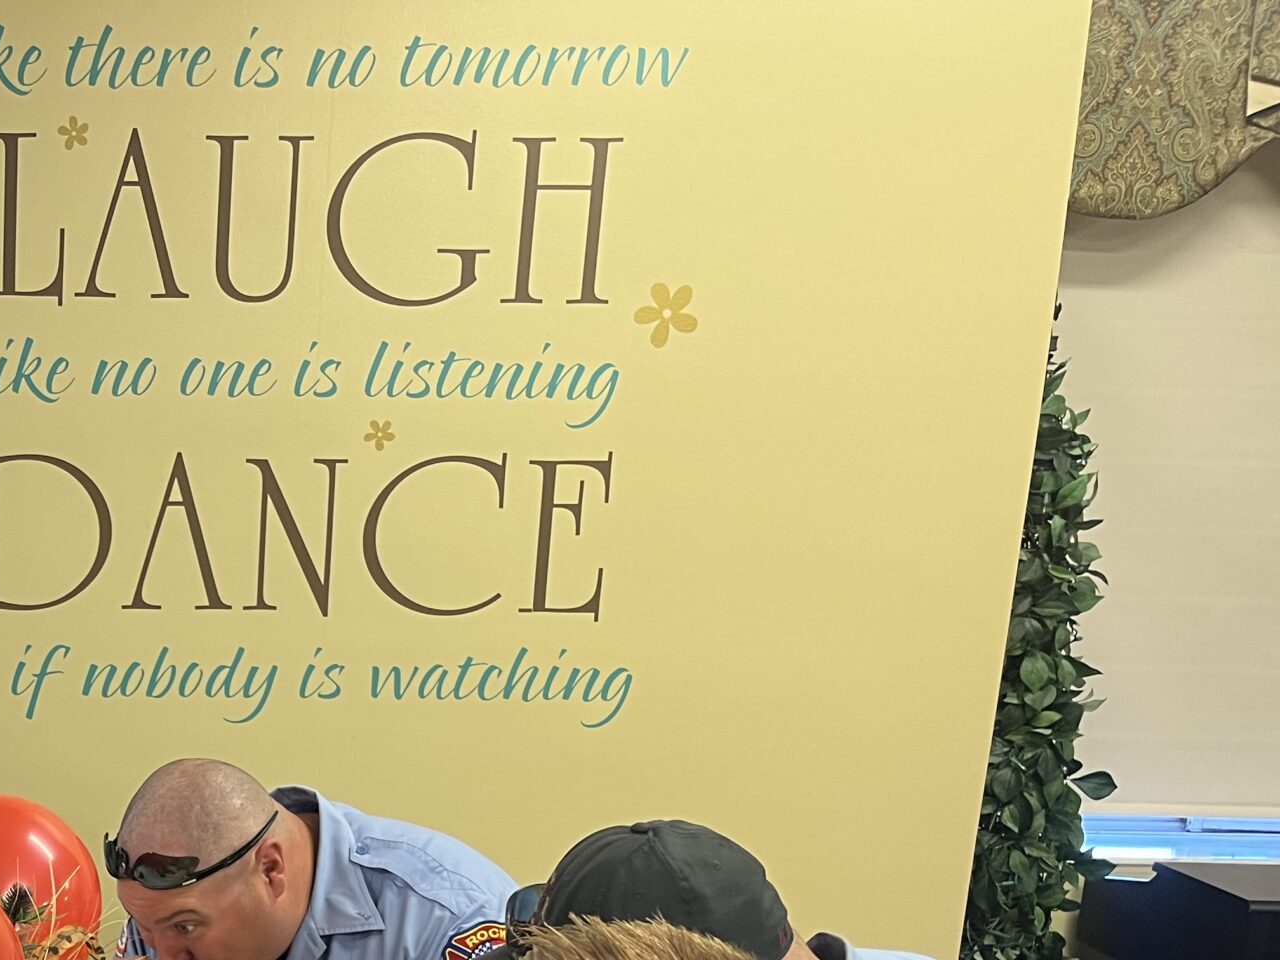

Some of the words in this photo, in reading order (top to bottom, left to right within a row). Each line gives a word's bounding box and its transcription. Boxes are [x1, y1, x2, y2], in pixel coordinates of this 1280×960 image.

[64, 25, 217, 89] there
[233, 26, 282, 89] is
[306, 44, 377, 88] no
[399, 35, 689, 89] tomorrow
[91, 355, 158, 398] no
[179, 355, 277, 398] one
[294, 341, 340, 398] is
[364, 341, 621, 429] listening
[10, 645, 70, 720] if
[81, 647, 279, 723] nobody
[298, 647, 345, 700] is
[369, 647, 634, 729] watching
